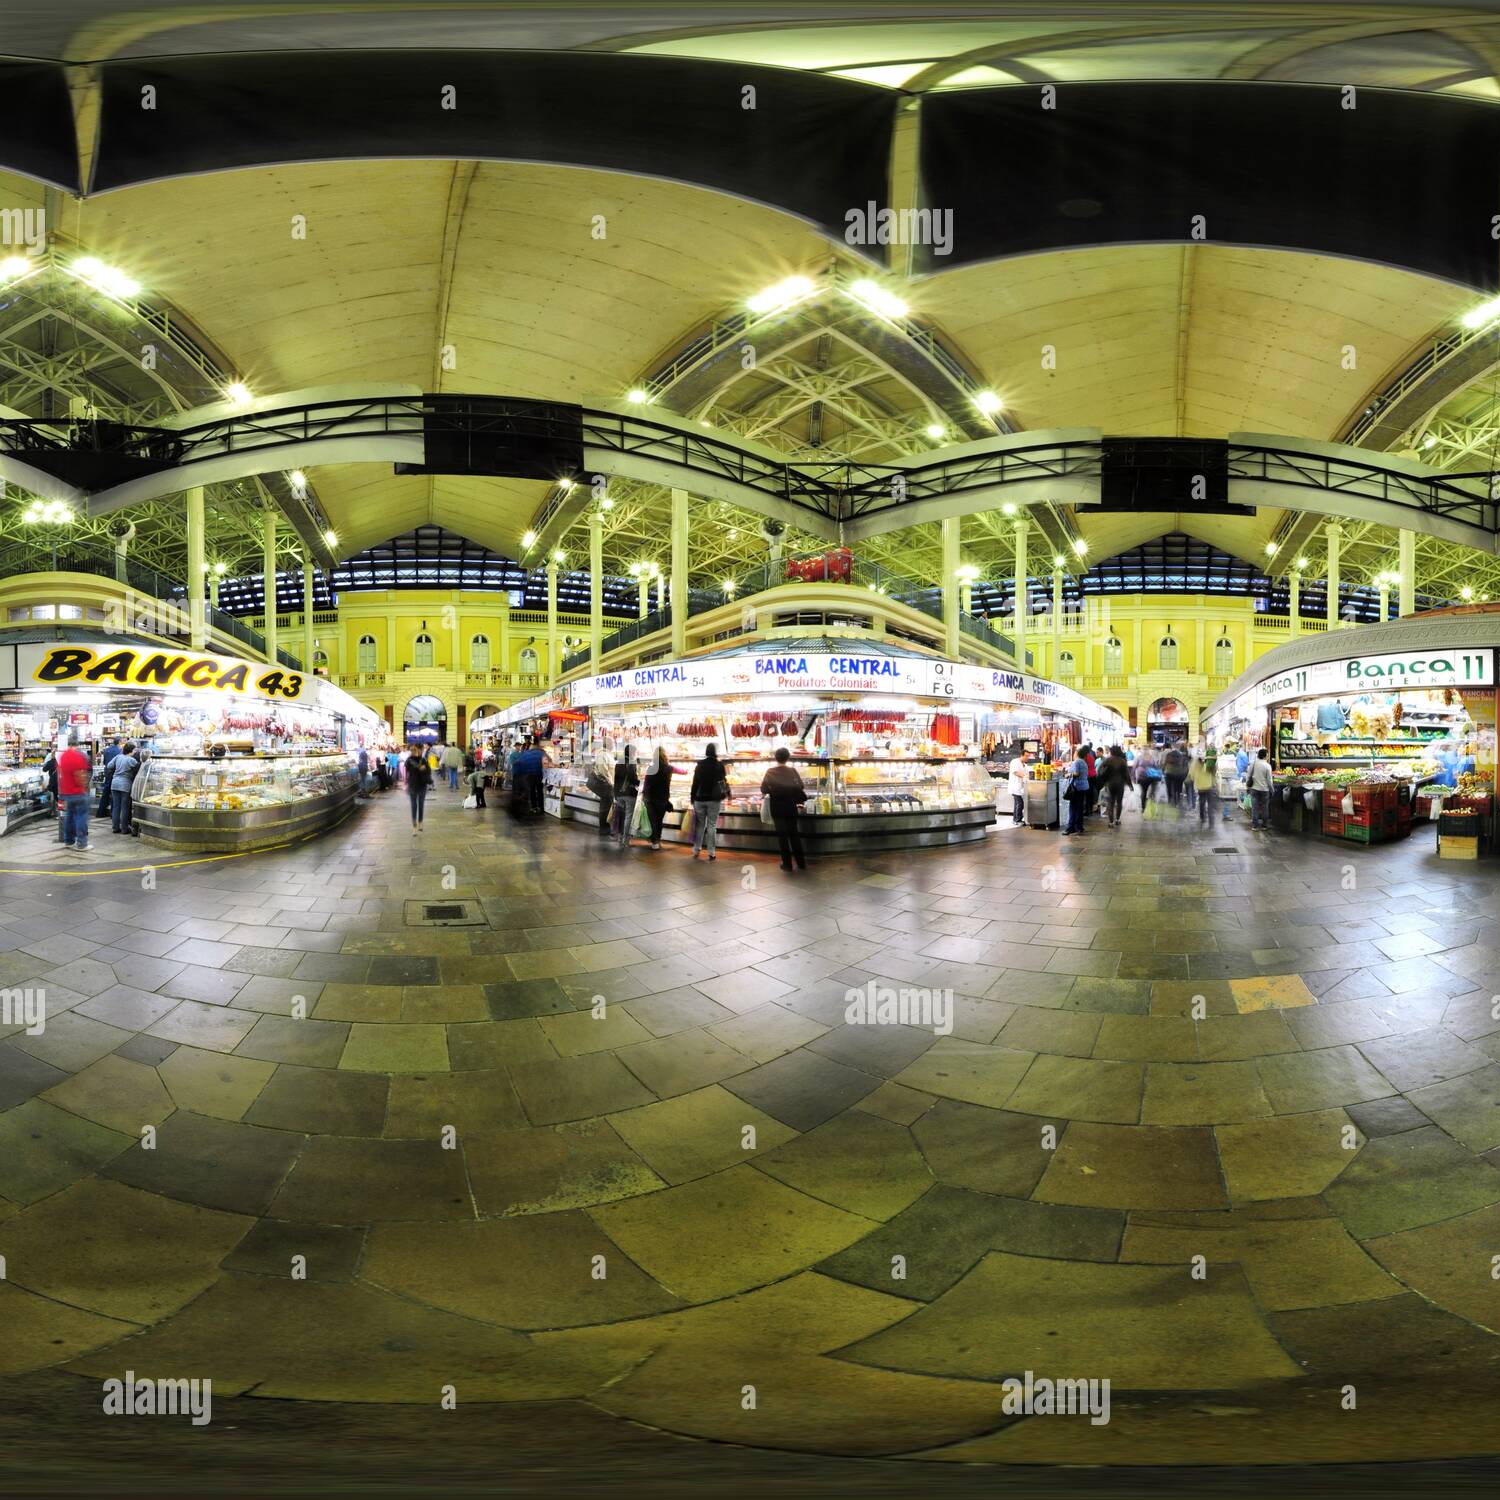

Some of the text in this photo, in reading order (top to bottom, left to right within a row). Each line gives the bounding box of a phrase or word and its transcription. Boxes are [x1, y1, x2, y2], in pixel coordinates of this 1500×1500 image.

[35, 648, 303, 698] BANCA 43
[755, 657, 901, 676] BANCA CENTRAL
[934, 663, 944, 676] Q
[1346, 655, 1484, 681] Banca 11
[595, 666, 688, 690] BANCA CENTRAL
[692, 677, 705, 687] 54
[778, 676, 878, 689] Produtos Coloniais
[992, 671, 1025, 691] BANCA
[1262, 671, 1307, 696] Banca 11
[1346, 675, 1456, 688] RUTEIRA
[933, 682, 954, 695] F G
